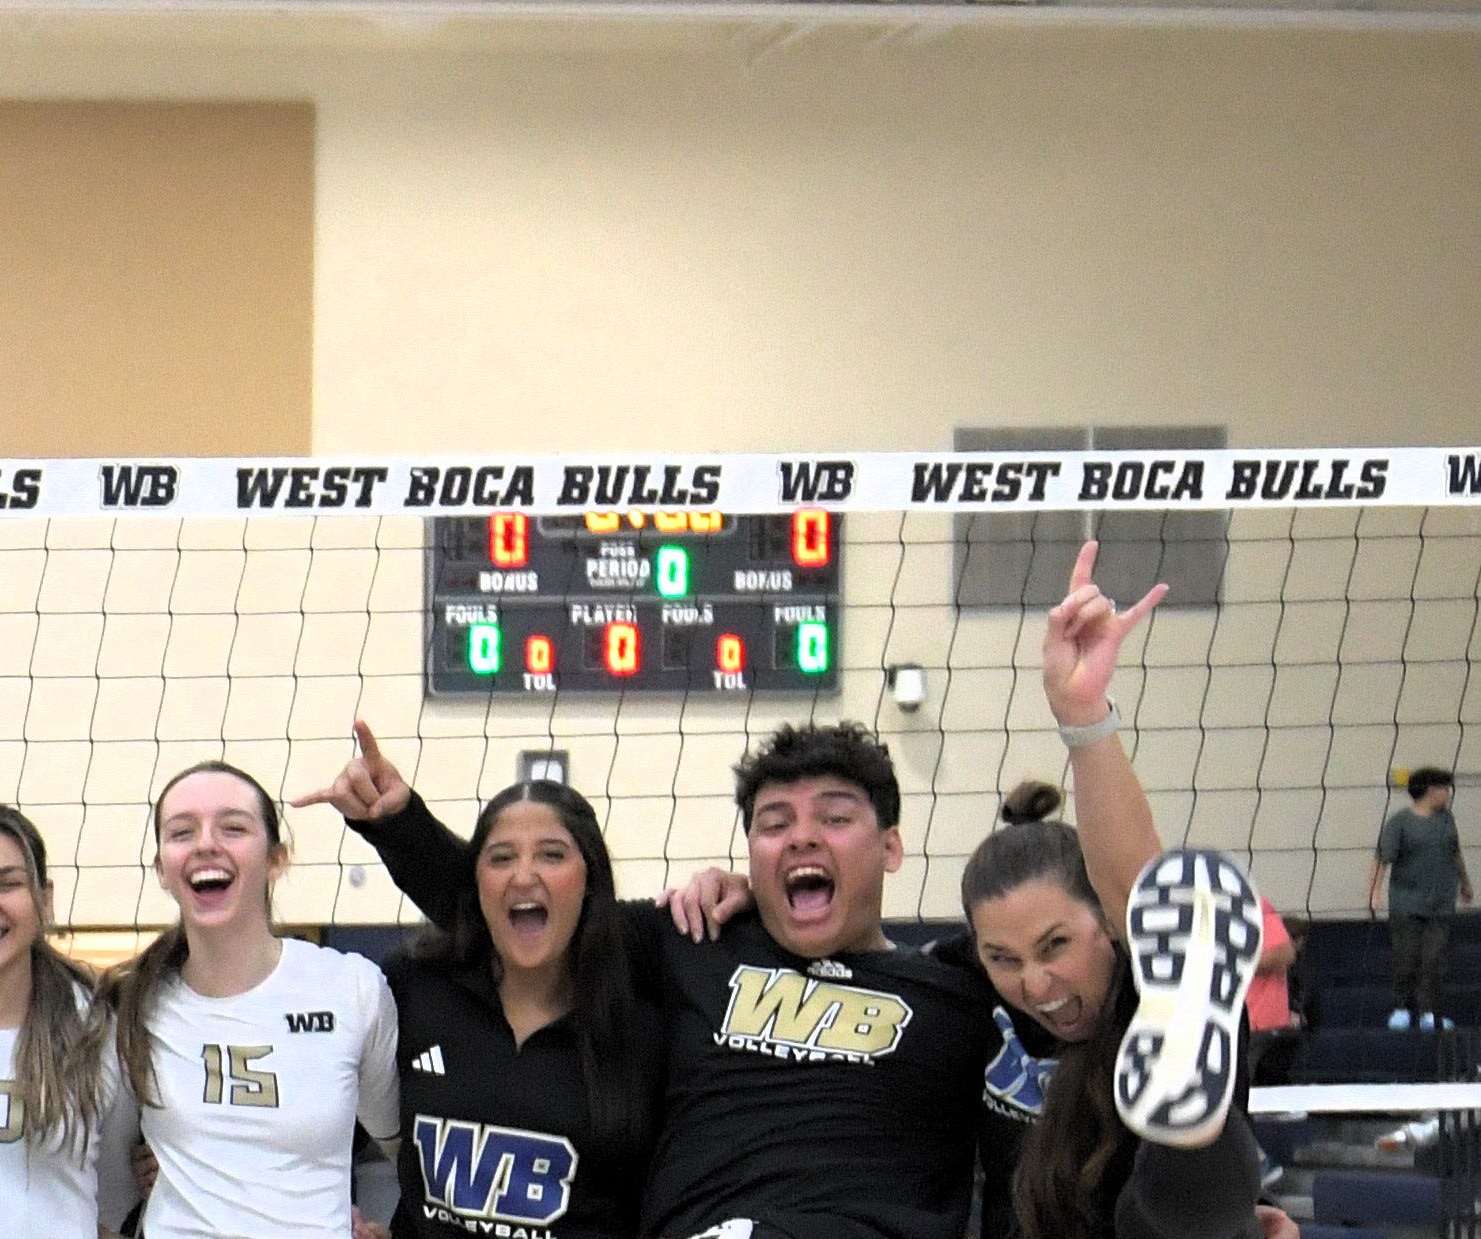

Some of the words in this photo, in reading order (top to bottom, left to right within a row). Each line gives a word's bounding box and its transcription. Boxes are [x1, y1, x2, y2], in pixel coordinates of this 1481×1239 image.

[101, 465, 179, 506] WB
[235, 467, 389, 508] WEST
[403, 466, 535, 507] BOCA
[555, 465, 722, 506] BULLS
[779, 461, 856, 502] WB
[910, 462, 1063, 502] WEST
[1077, 460, 1206, 501] BOCA
[1224, 459, 1390, 500] BULLS
[1446, 454, 1481, 494] W
[657, 546, 689, 598] 0
[469, 623, 502, 675] 0
[525, 634, 556, 675] 0
[603, 621, 641, 678] 0
[715, 633, 745, 674] 0
[796, 621, 829, 674] 0
[285, 1011, 336, 1035] WB
[727, 963, 915, 1057] WB
[200, 1043, 280, 1109] 15
[413, 1113, 581, 1227] WB
